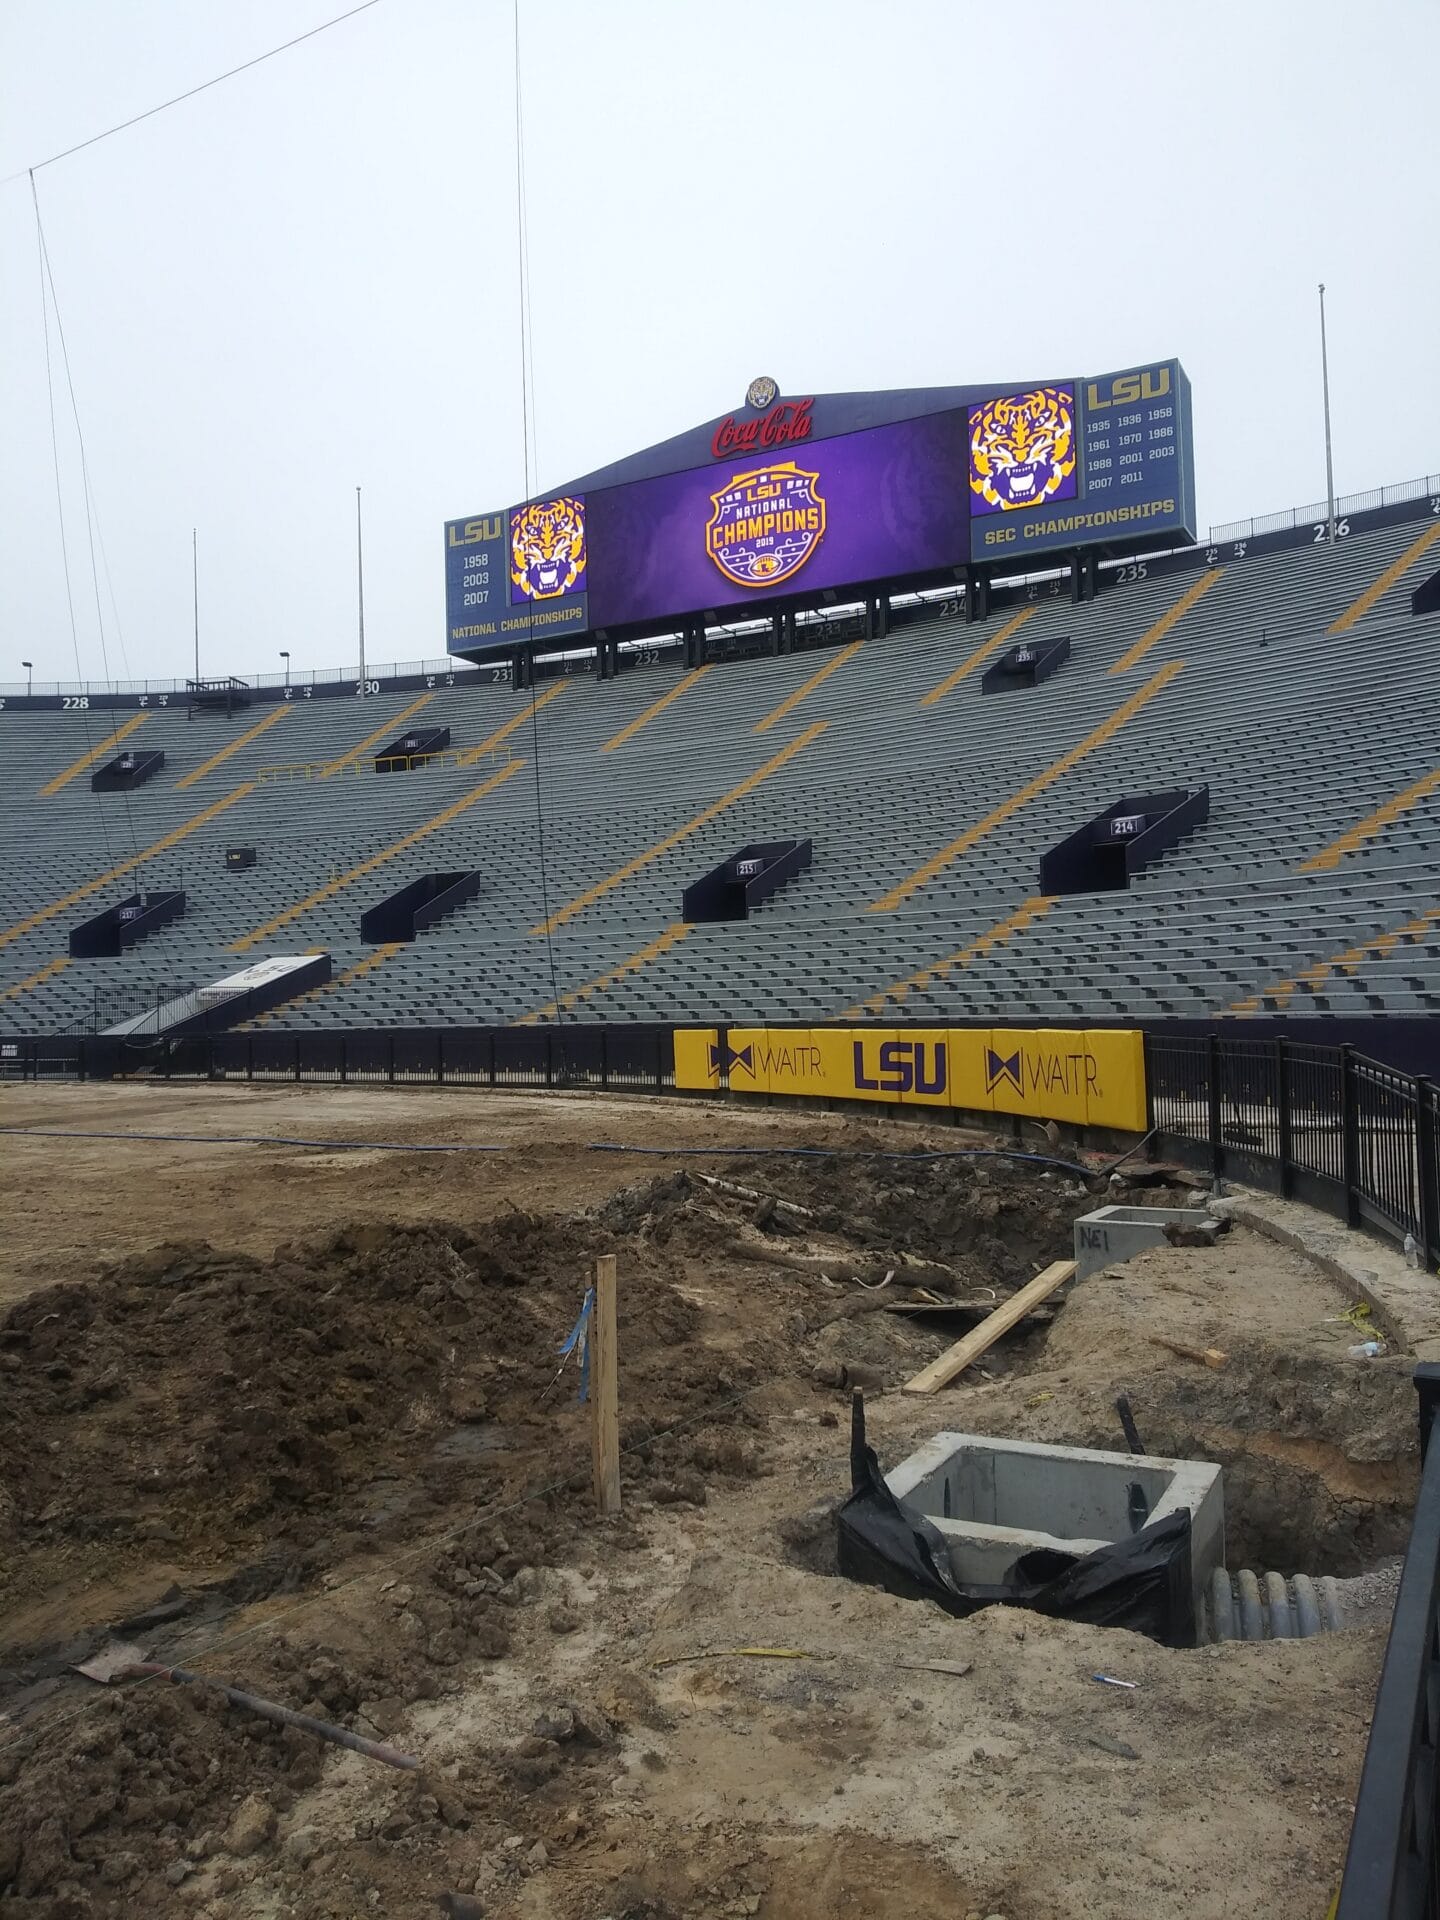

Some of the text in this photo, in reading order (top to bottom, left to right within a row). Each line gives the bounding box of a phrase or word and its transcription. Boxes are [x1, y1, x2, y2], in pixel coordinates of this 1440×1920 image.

[1088, 368, 1170, 411] LSU
[1087, 407, 1172, 433] 1935 1936 1958
[1088, 427, 1173, 452] 1961 1970 1986
[1088, 446, 1175, 471] 1988 2001 2003
[1088, 471, 1144, 490] 2007 2011
[747, 482, 781, 502] LSU
[736, 498, 793, 519] NATIONAL
[713, 506, 819, 549] CHAMPIONS
[984, 499, 1175, 545] SEC CHAMPIONSHIPS
[449, 517, 501, 547] LSU
[755, 537, 774, 548] 2019
[463, 554, 489, 568] 1958
[463, 574, 489, 587] 2003
[1116, 562, 1148, 584] 235
[463, 591, 489, 606] 2007
[940, 598, 967, 617] 234
[452, 607, 583, 639] NATIONAL CHAMPIONSHIPS
[634, 650, 660, 666] 232
[1018, 653, 1031, 662] 235
[492, 669, 513, 682] 231
[62, 697, 89, 710] 228
[1114, 821, 1133, 834] 214
[739, 864, 754, 874] 215
[121, 911, 133, 919] 217
[854, 1040, 947, 1095] LSU
